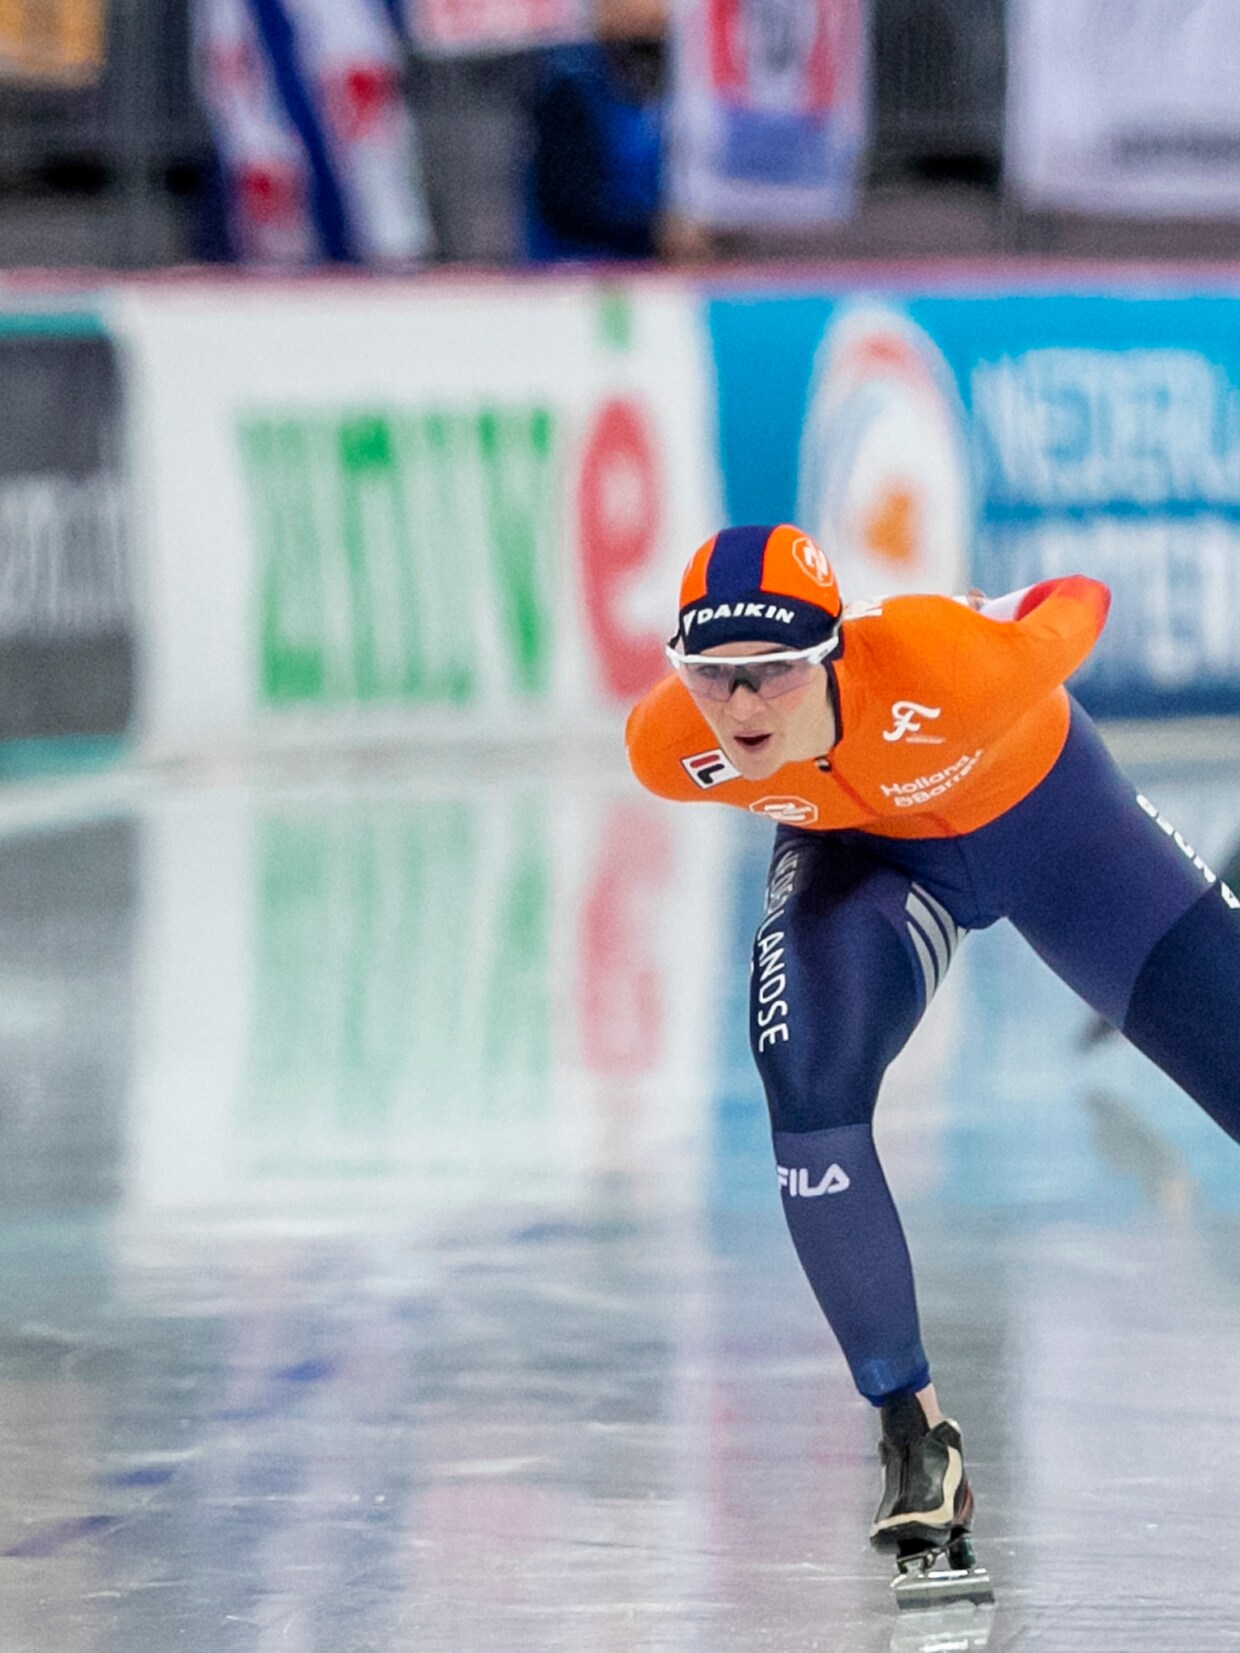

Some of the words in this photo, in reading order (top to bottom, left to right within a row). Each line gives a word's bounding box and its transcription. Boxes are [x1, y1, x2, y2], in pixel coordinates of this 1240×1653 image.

[697, 602, 795, 625] DAIKIN
[880, 754, 970, 797] Holland
[777, 1162, 850, 1197] FILA
